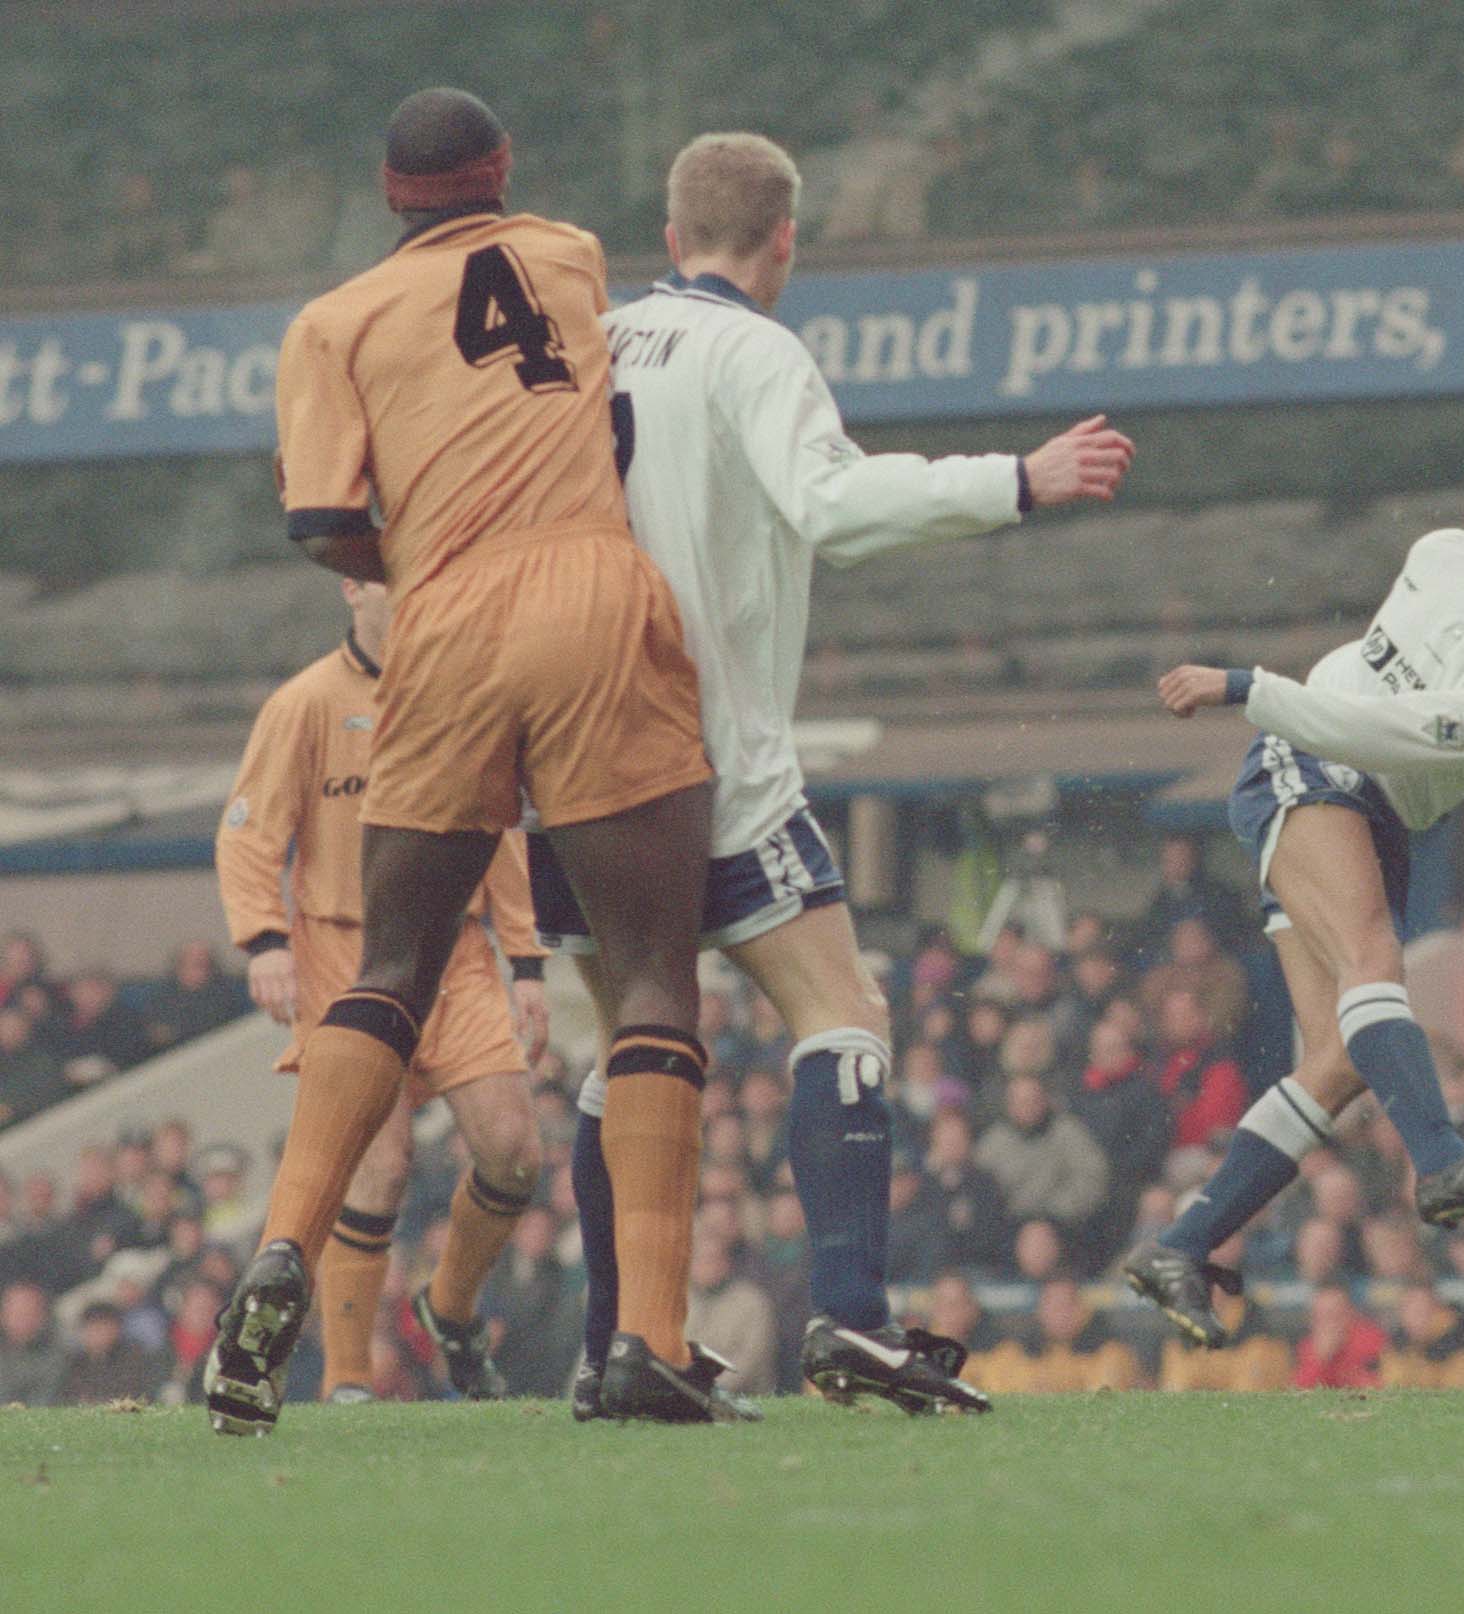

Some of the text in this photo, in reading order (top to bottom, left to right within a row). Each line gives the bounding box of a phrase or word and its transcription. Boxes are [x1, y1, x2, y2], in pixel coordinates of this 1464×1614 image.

[452, 242, 580, 394] 4
[801, 275, 977, 381] and
[1000, 269, 1447, 396] printers,
[1395, 655, 1427, 690] HEW
[322, 774, 368, 798] GO
